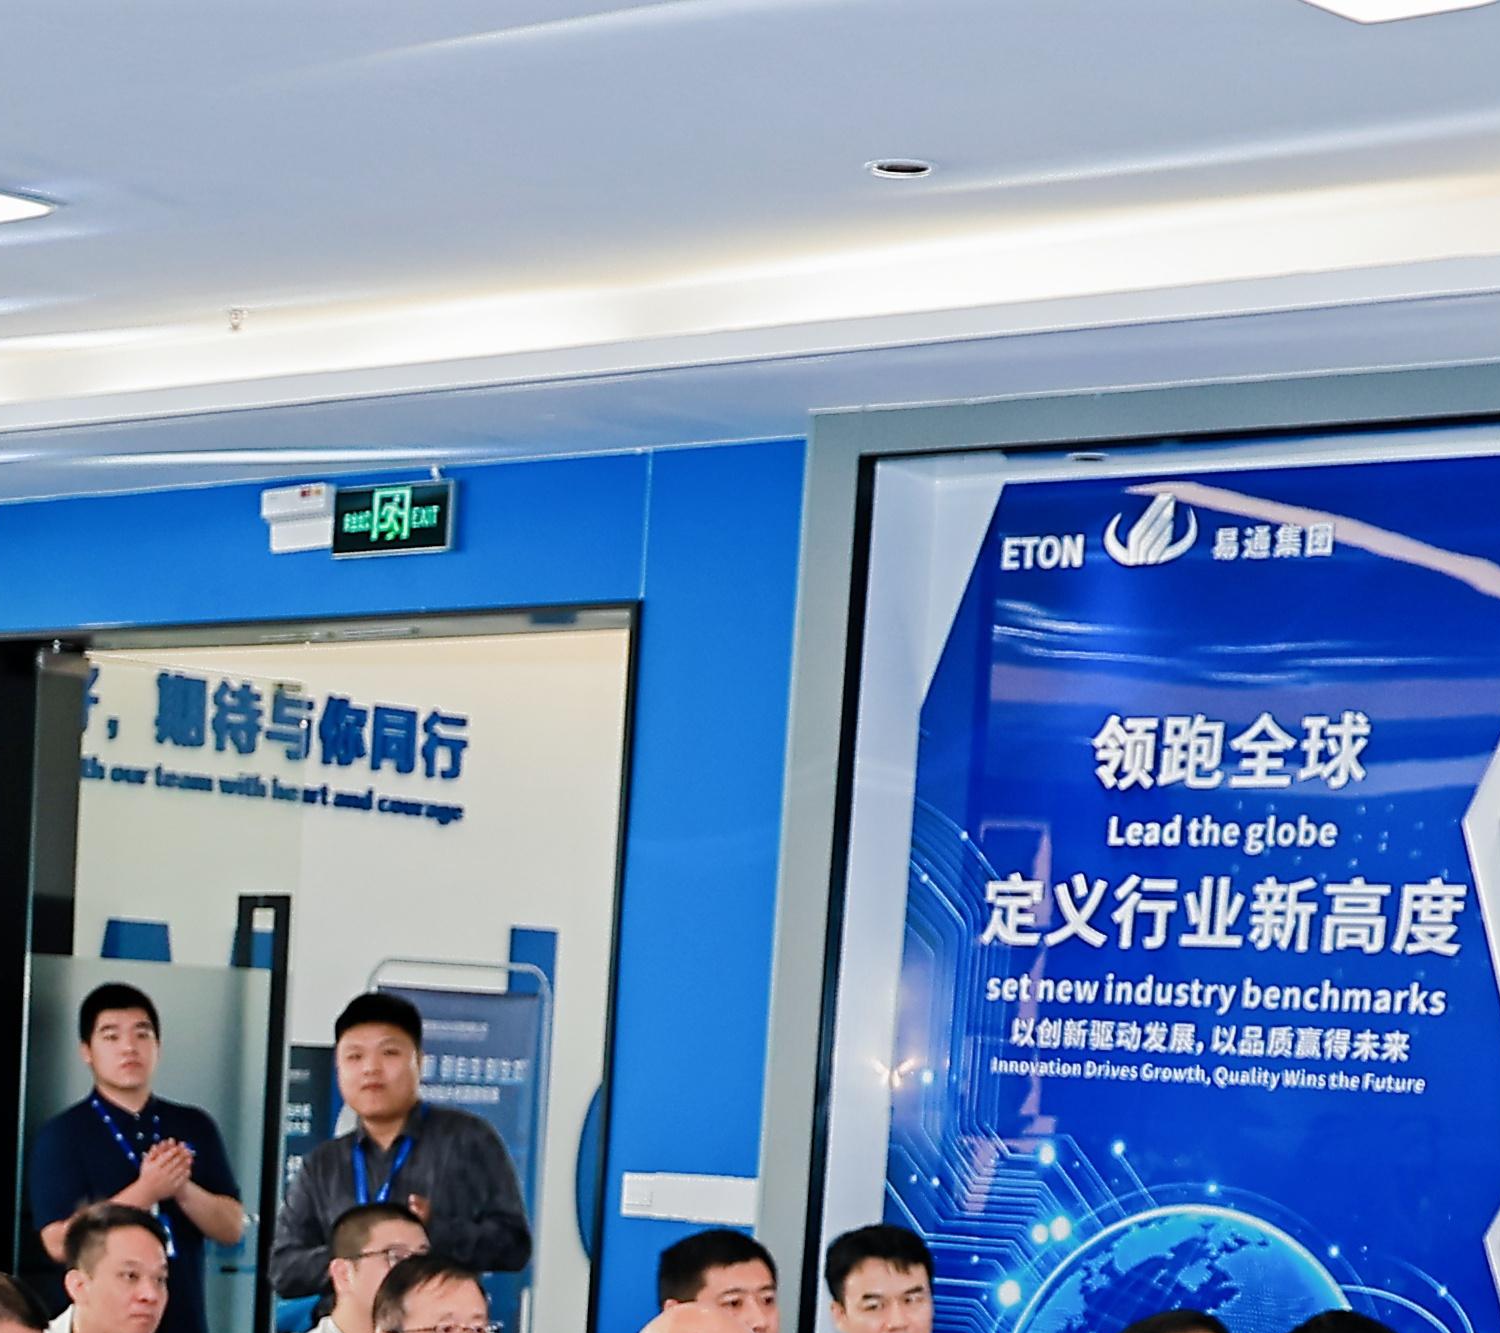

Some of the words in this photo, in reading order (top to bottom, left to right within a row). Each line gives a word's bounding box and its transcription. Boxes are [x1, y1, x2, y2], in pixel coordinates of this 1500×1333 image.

[1001, 533, 1084, 570] ETON
[1212, 523, 1334, 560] 易通集团
[1090, 711, 1371, 792] 领跑全球
[1107, 814, 1182, 847] Lead
[1187, 814, 1241, 847] the
[1243, 814, 1338, 855] globe
[979, 871, 1467, 956] 定义行业新高度
[986, 973, 1031, 1002] set
[1038, 977, 1099, 1003] new
[1104, 973, 1236, 1016] industry
[1241, 976, 1447, 1016] benchmarks
[990, 1056, 1081, 1078] Innovation
[1084, 1060, 1138, 1080] Drives
[1140, 1062, 1211, 1086] Growth,
[1213, 1066, 1280, 1092] Quality
[1282, 1069, 1325, 1089] Wins
[1327, 1070, 1359, 1091] the
[1362, 1073, 1426, 1094] Future
